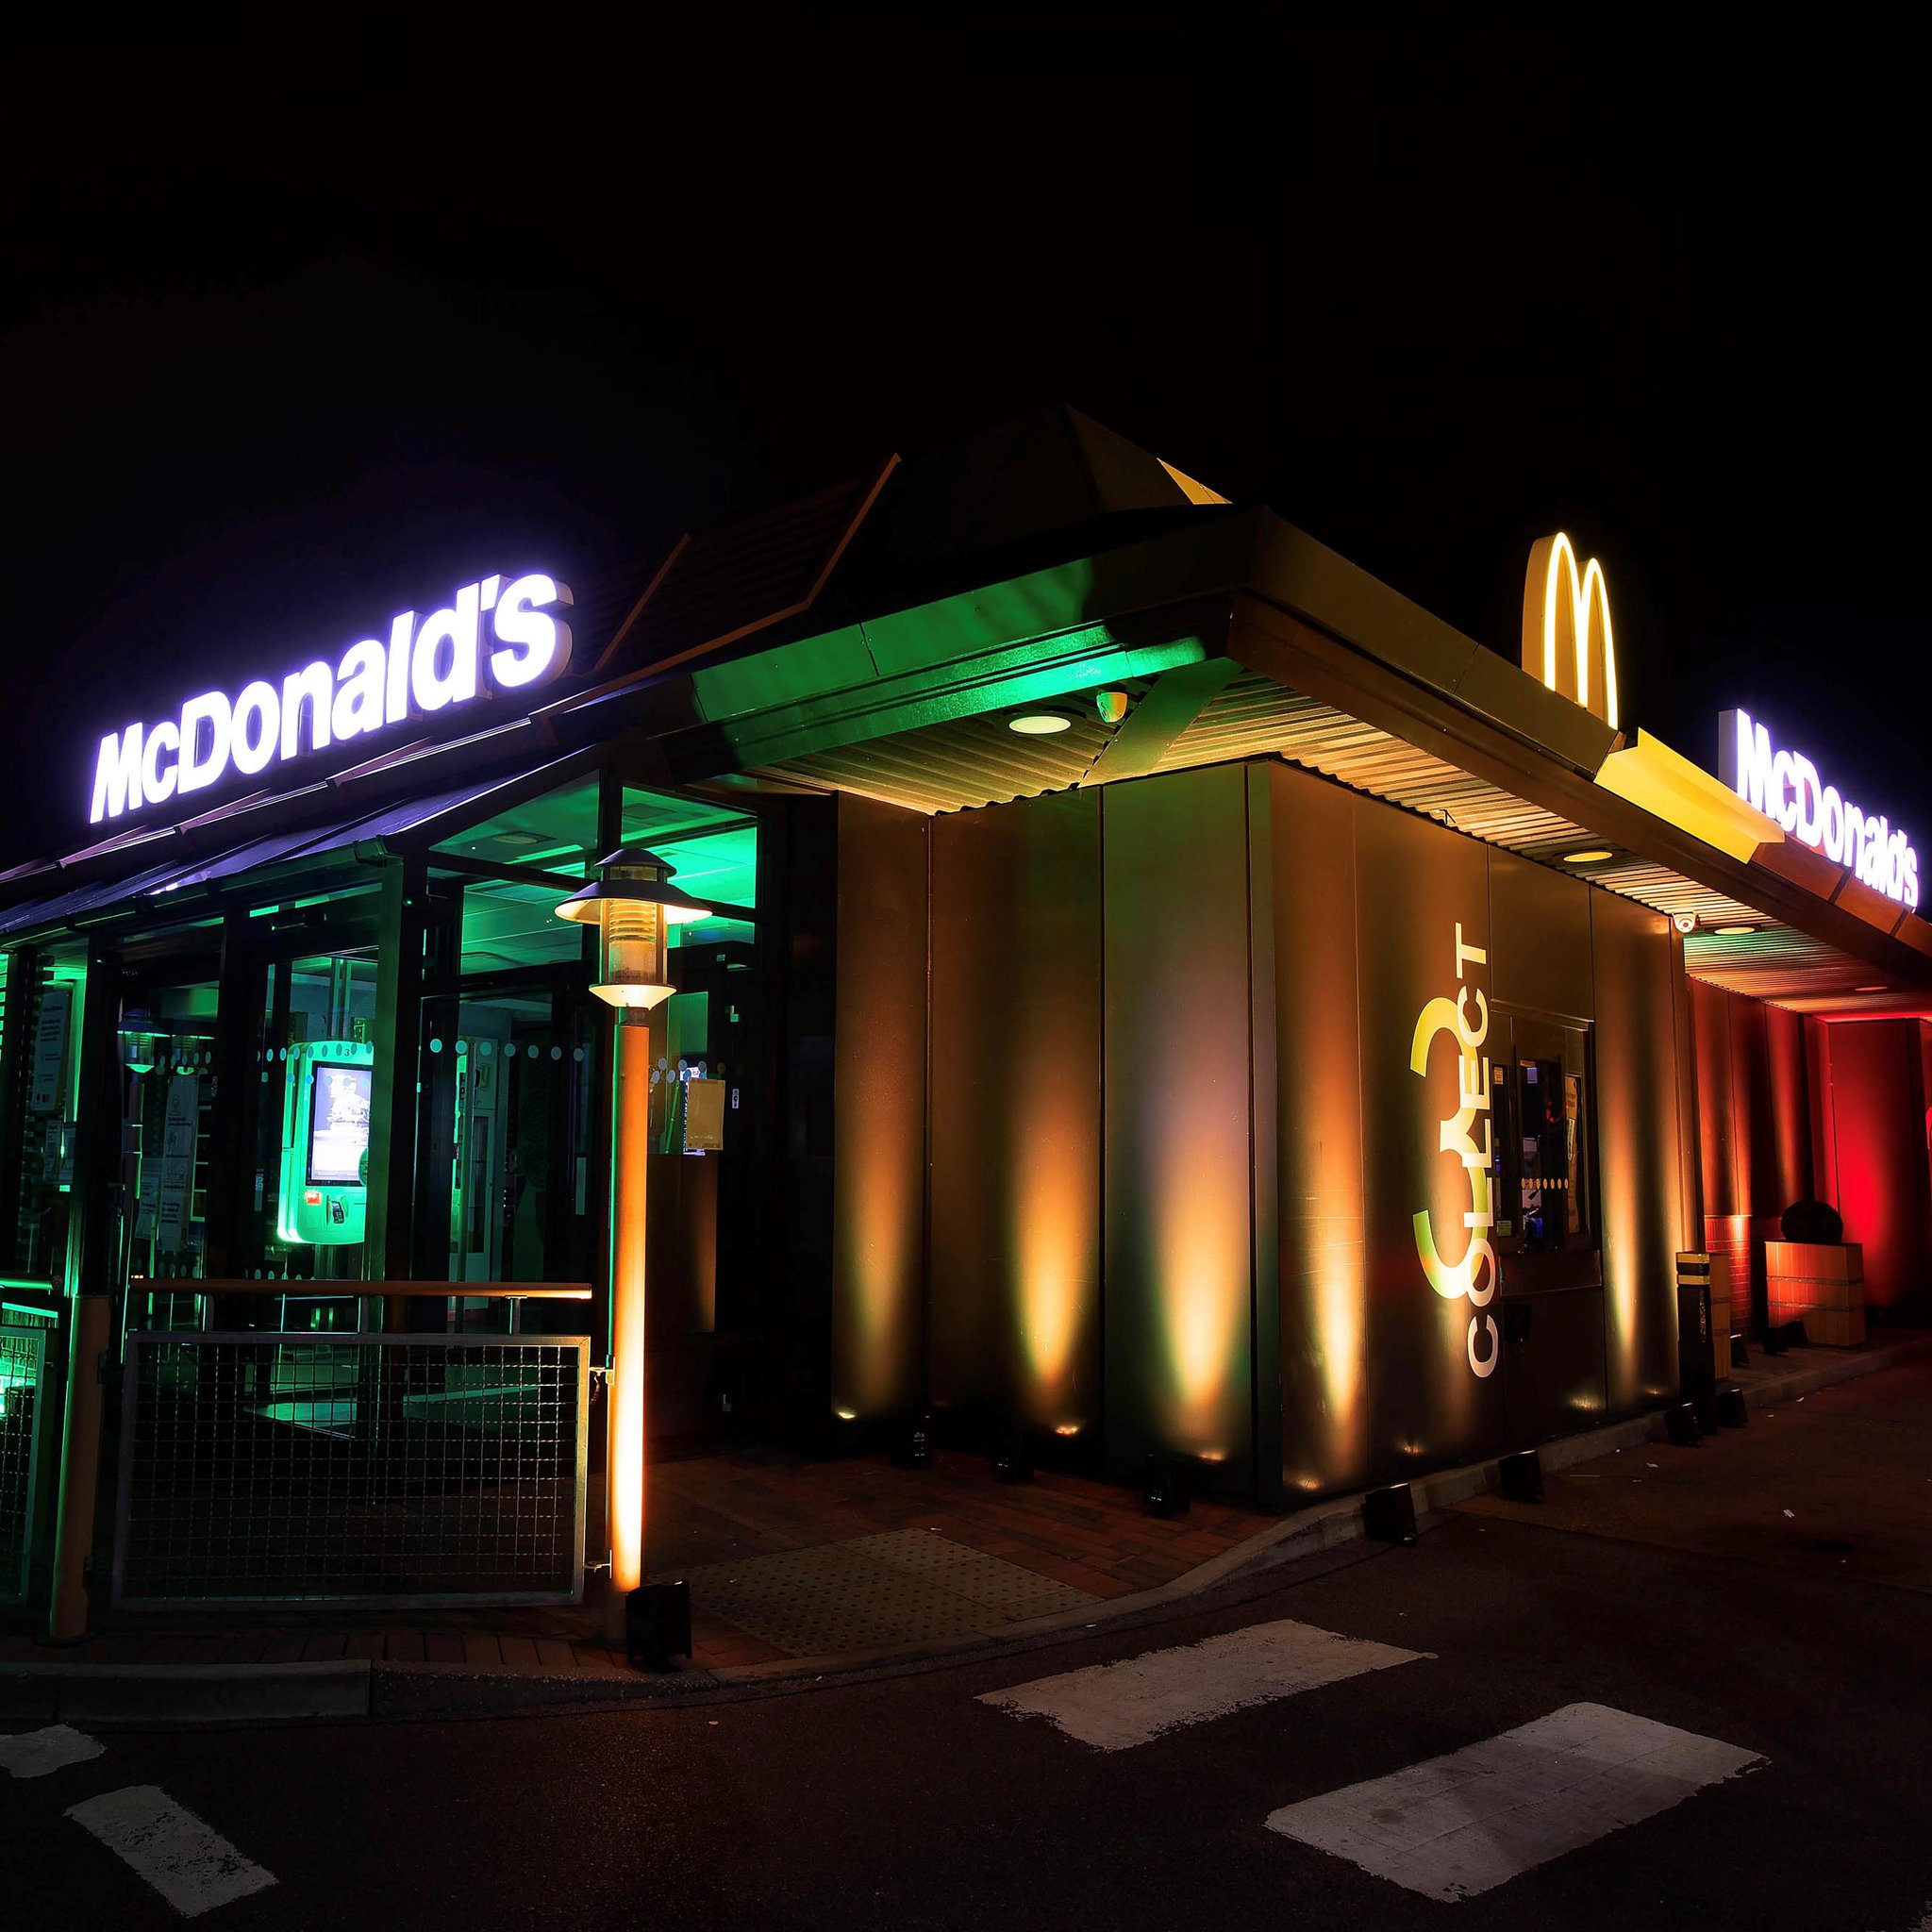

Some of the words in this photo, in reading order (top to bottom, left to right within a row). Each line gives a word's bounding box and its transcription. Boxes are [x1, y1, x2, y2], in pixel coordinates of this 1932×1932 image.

[90, 573, 558, 824] McDonald's
[1409, 996, 1490, 1300] 3
[1454, 922, 1499, 1378] COLLECT
